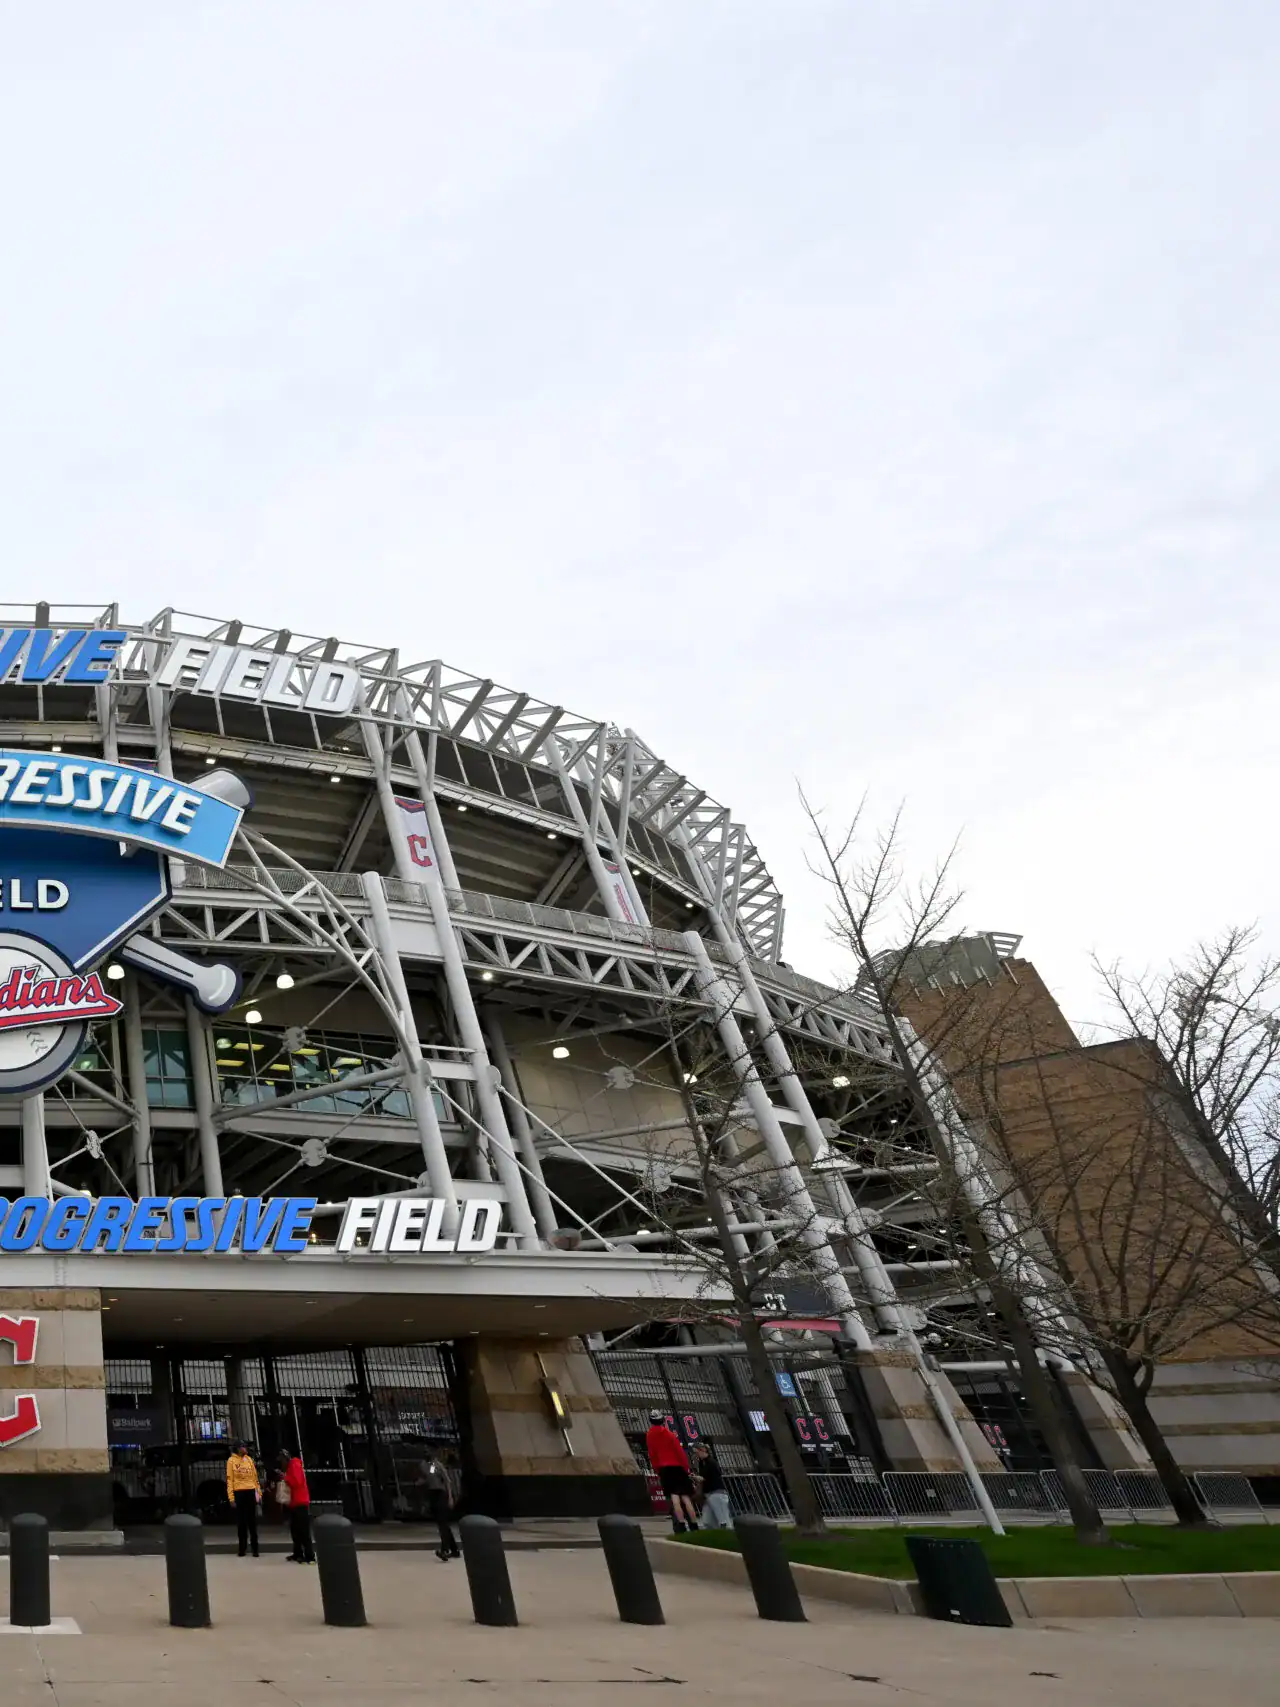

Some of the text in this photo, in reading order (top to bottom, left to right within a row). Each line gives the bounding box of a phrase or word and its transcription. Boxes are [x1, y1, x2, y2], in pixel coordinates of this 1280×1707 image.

[157, 637, 361, 715] FIELD
[407, 834, 432, 867] C
[337, 1197, 502, 1253] FIELD
